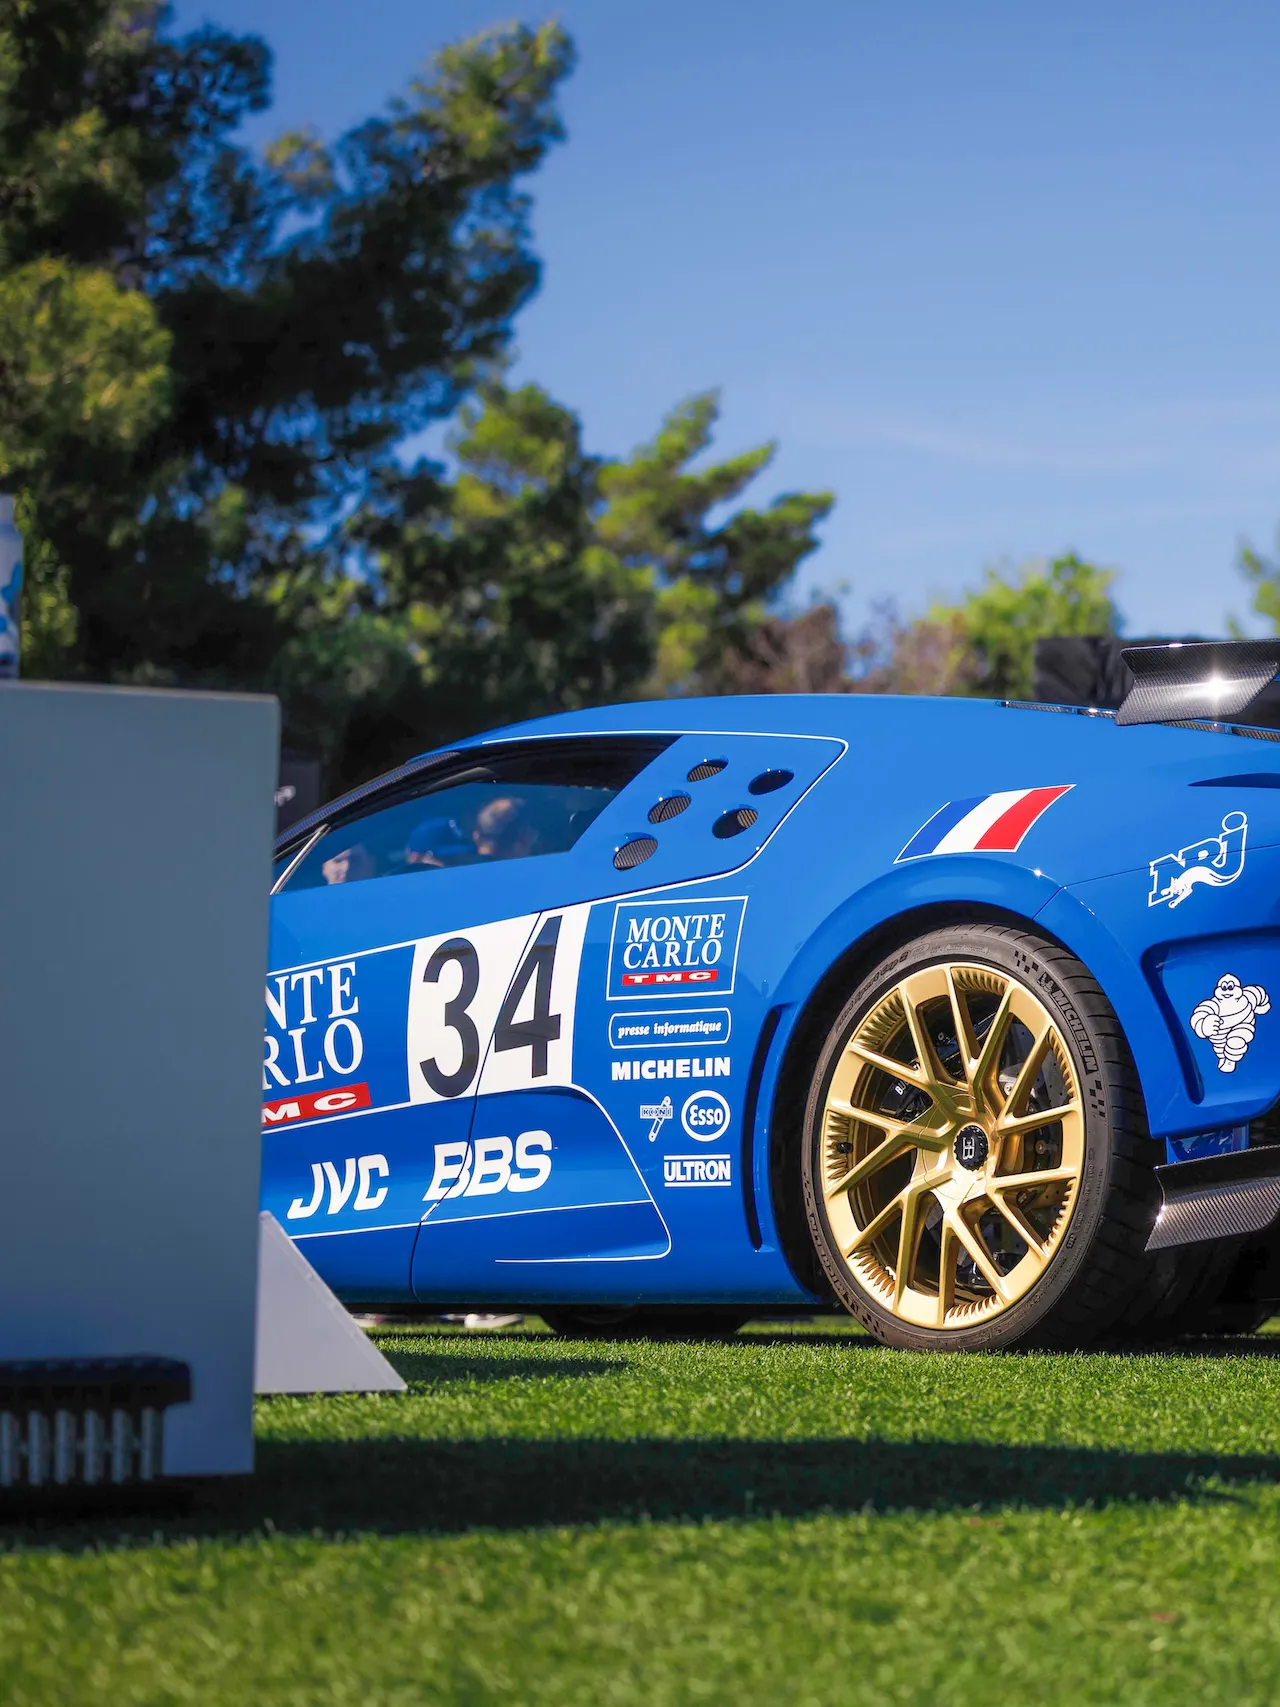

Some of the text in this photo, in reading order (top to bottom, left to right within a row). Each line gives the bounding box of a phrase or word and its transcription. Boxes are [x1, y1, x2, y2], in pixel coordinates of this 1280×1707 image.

[626, 913, 726, 943] MONTE
[623, 939, 722, 969] CARLO
[628, 971, 712, 983] TMC
[265, 961, 359, 1030] NTE
[420, 915, 563, 1098] 34
[618, 1021, 722, 1038] presse informatique
[1052, 989, 1099, 1073] MICHELIN
[262, 1018, 363, 1090] RLO
[611, 1057, 731, 1081] MICHELIN
[261, 1092, 357, 1123] MC
[422, 1130, 552, 1201] BBS
[664, 1160, 731, 1182] ULTRON
[287, 1154, 389, 1219] JVC
